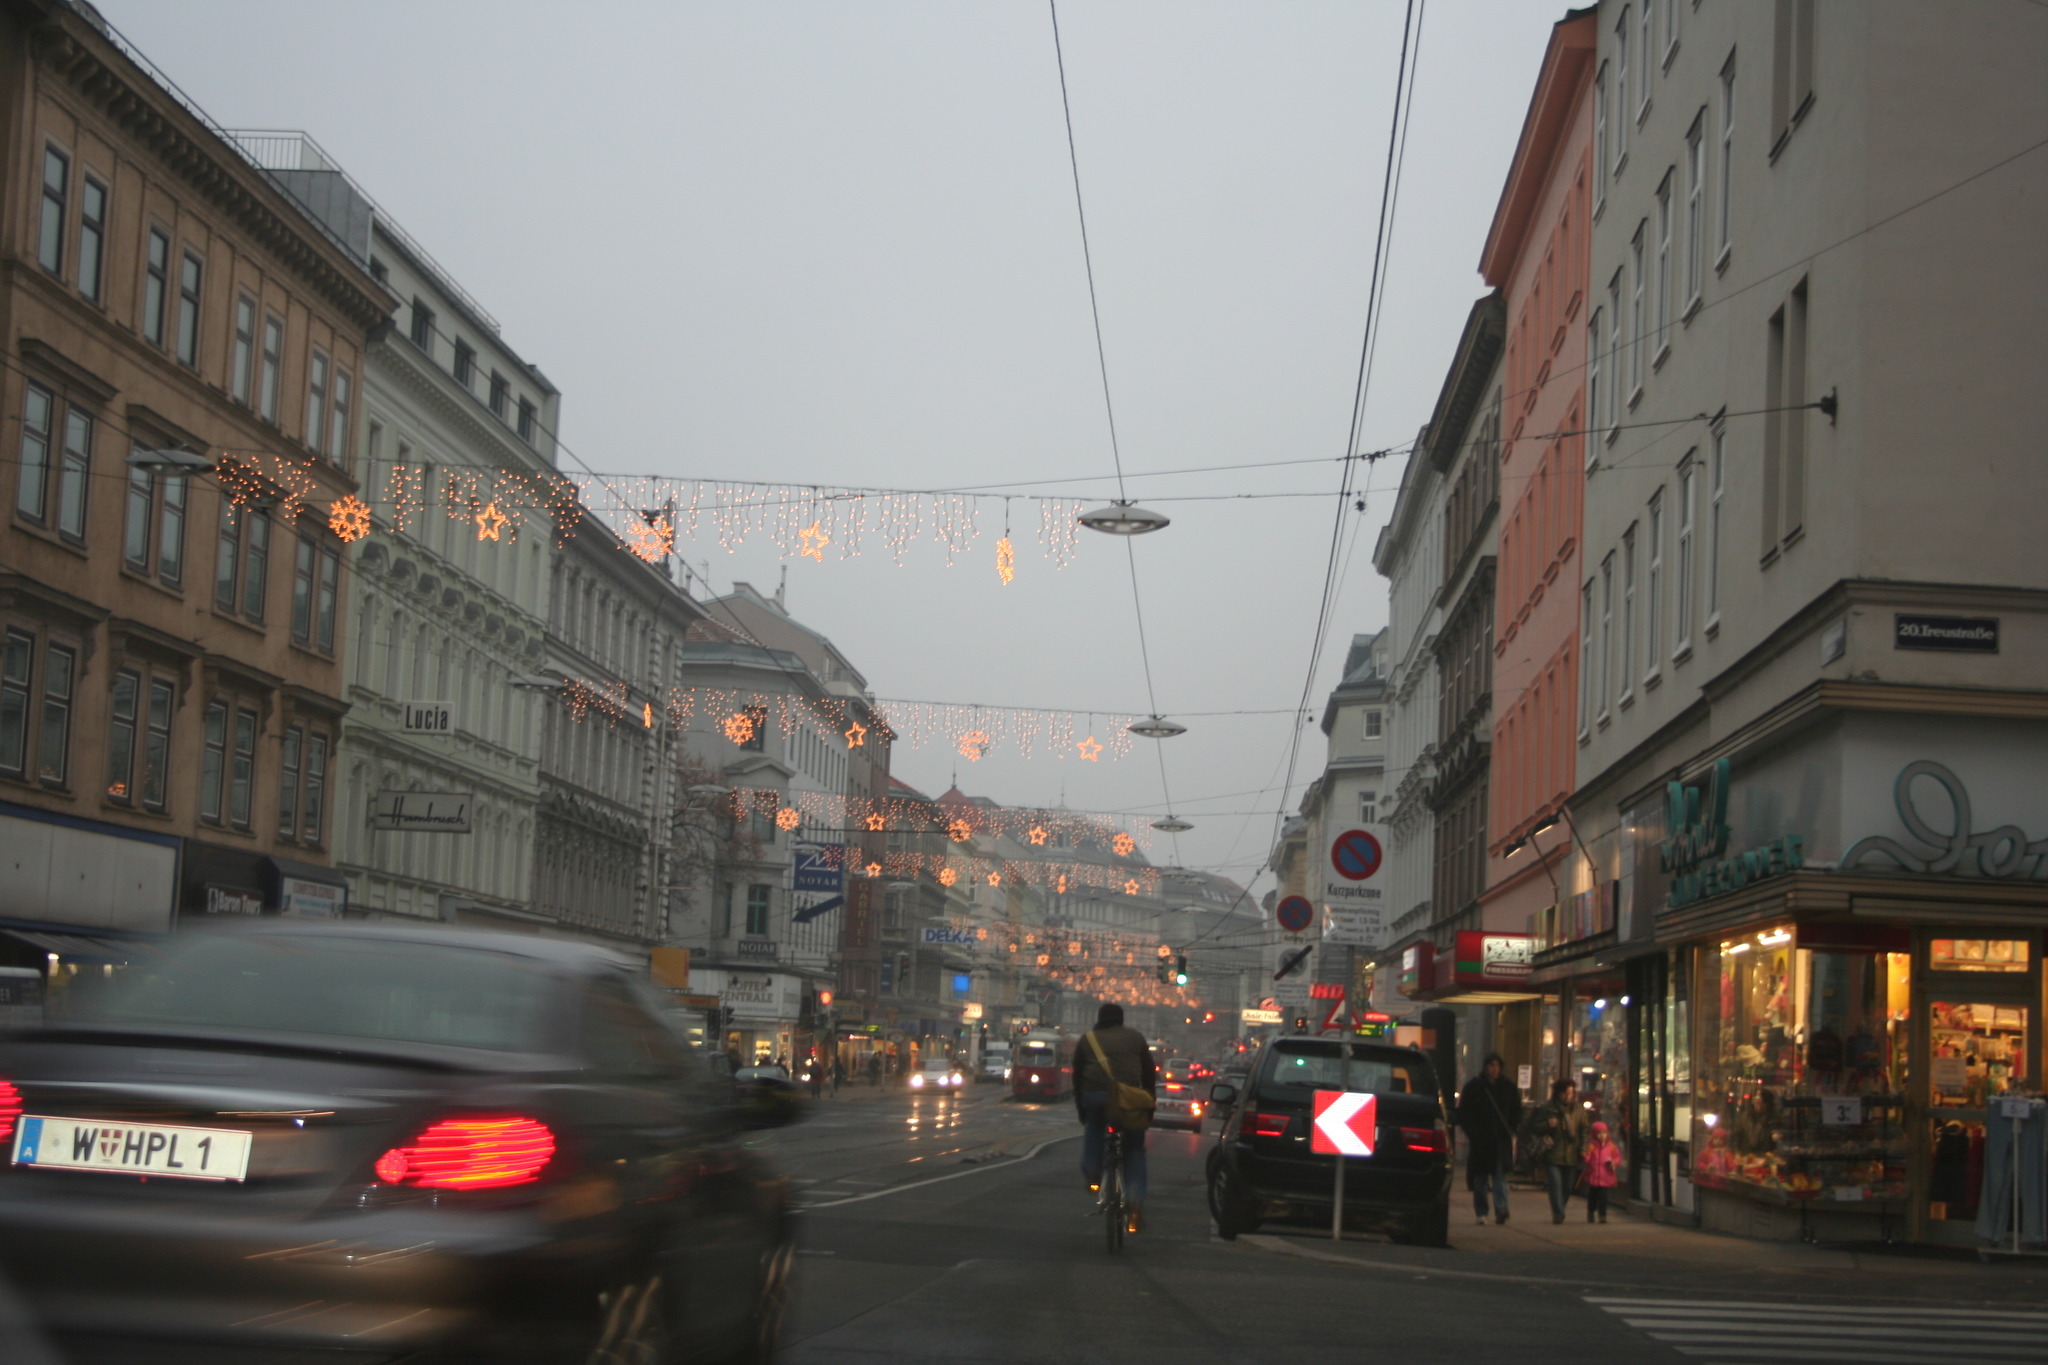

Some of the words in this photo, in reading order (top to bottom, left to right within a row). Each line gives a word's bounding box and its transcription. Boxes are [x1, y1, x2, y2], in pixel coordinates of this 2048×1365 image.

[405, 704, 448, 730] Lucia
[799, 876, 839, 886] NOTAR
[1327, 883, 1382, 899] Kurzparkzone
[924, 928, 975, 943] DELKA
[739, 941, 776, 953] NOTAR
[23, 1146, 33, 1157] A
[73, 1126, 99, 1161] W
[122, 1129, 184, 1169] HPL
[197, 1135, 212, 1170] 1
